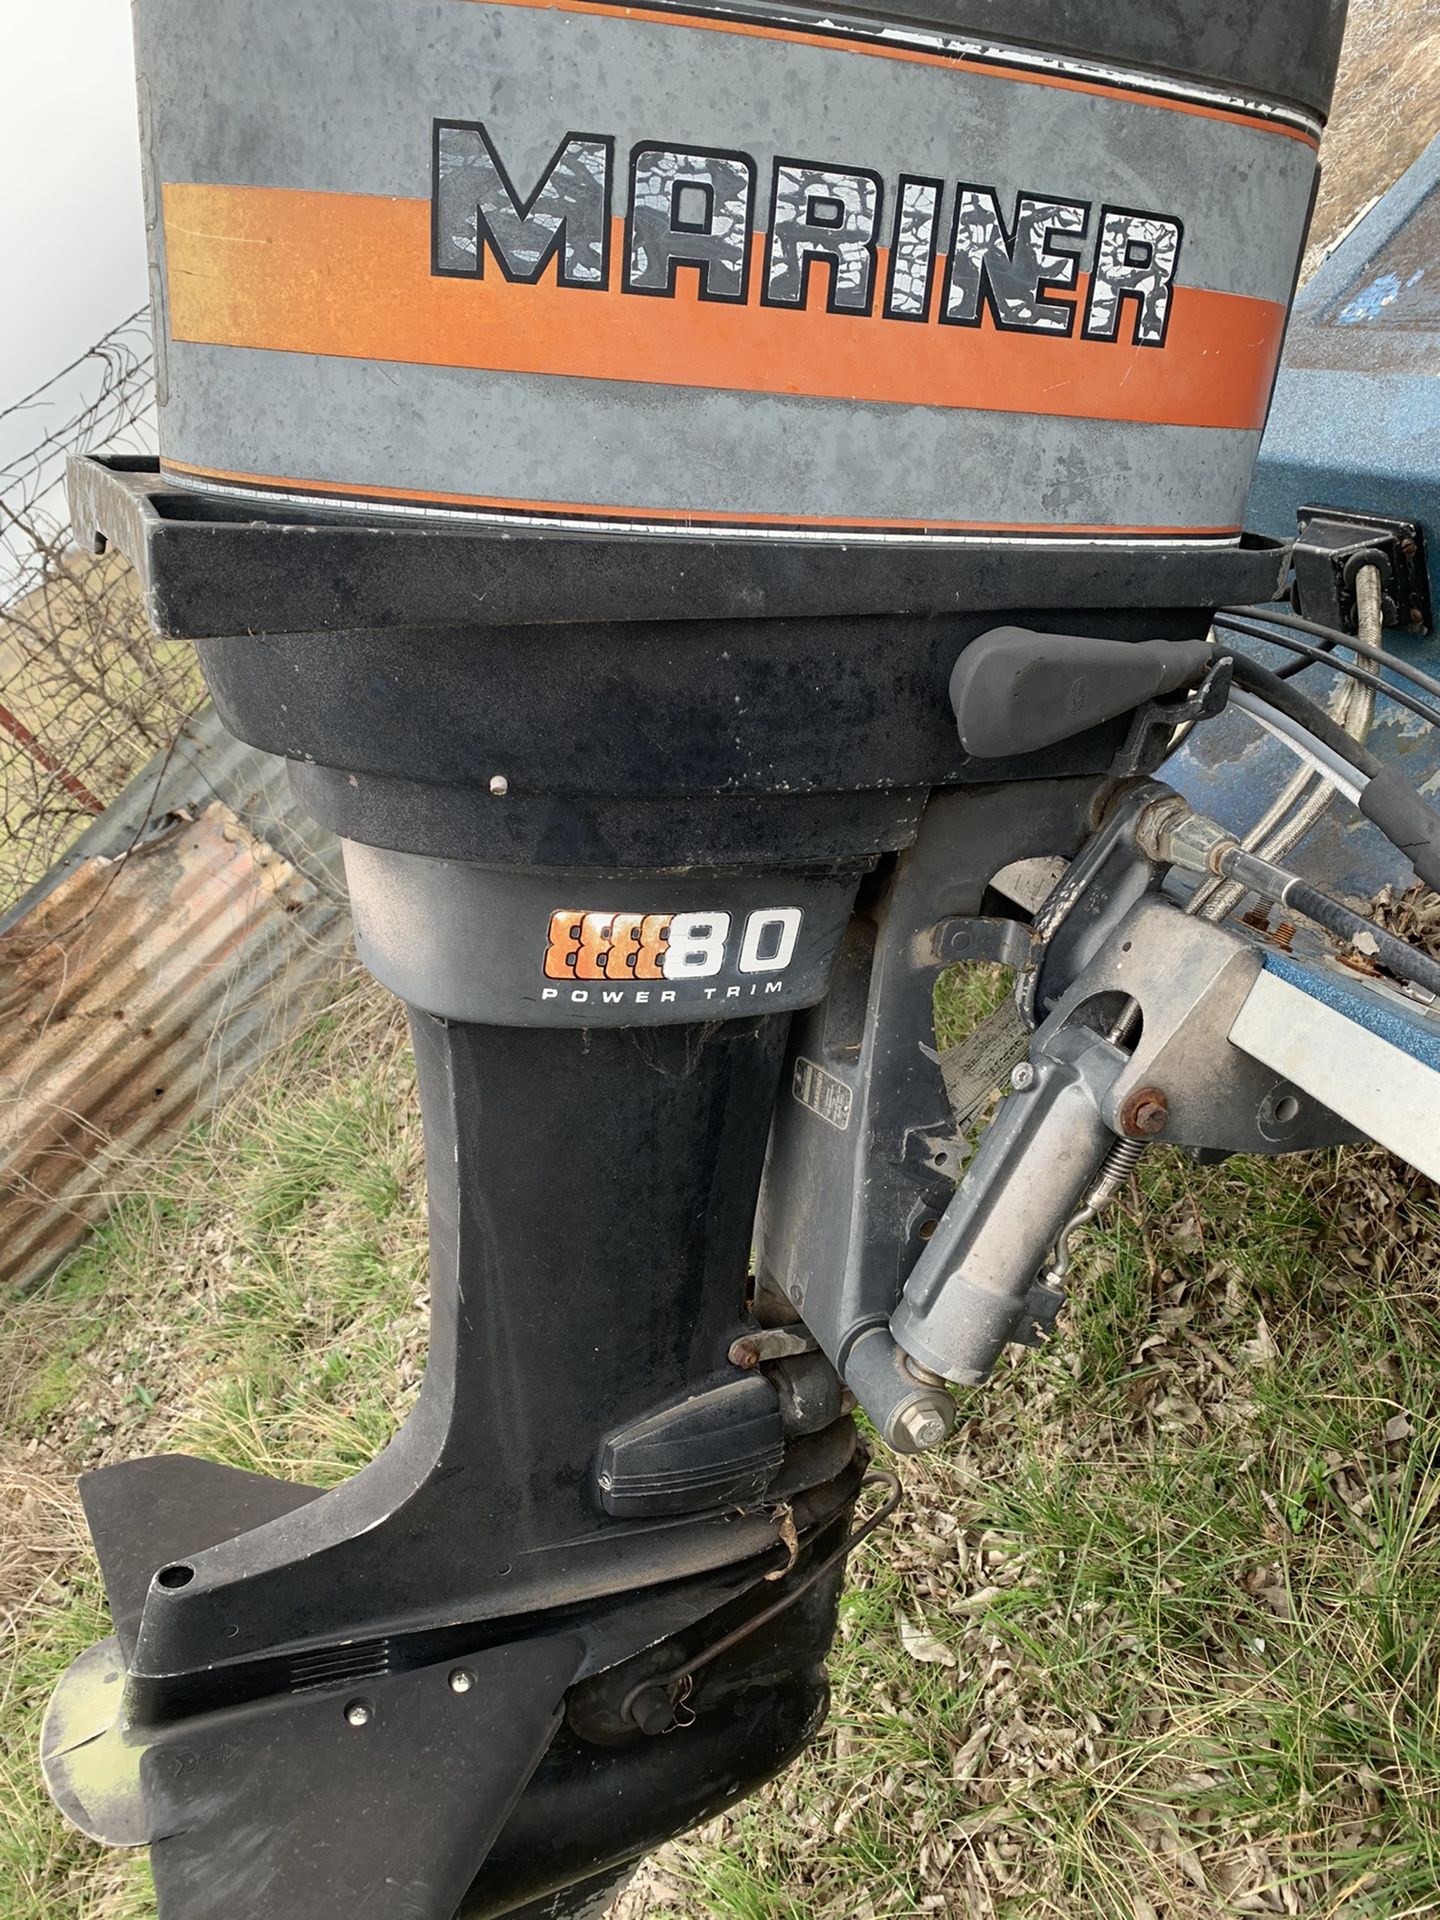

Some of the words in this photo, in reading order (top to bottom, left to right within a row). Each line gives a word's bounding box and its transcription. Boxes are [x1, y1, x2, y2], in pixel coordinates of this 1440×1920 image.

[430, 117, 1185, 348] MARINER
[541, 987, 676, 1004] POWER
[704, 981, 783, 1000] TRIM
